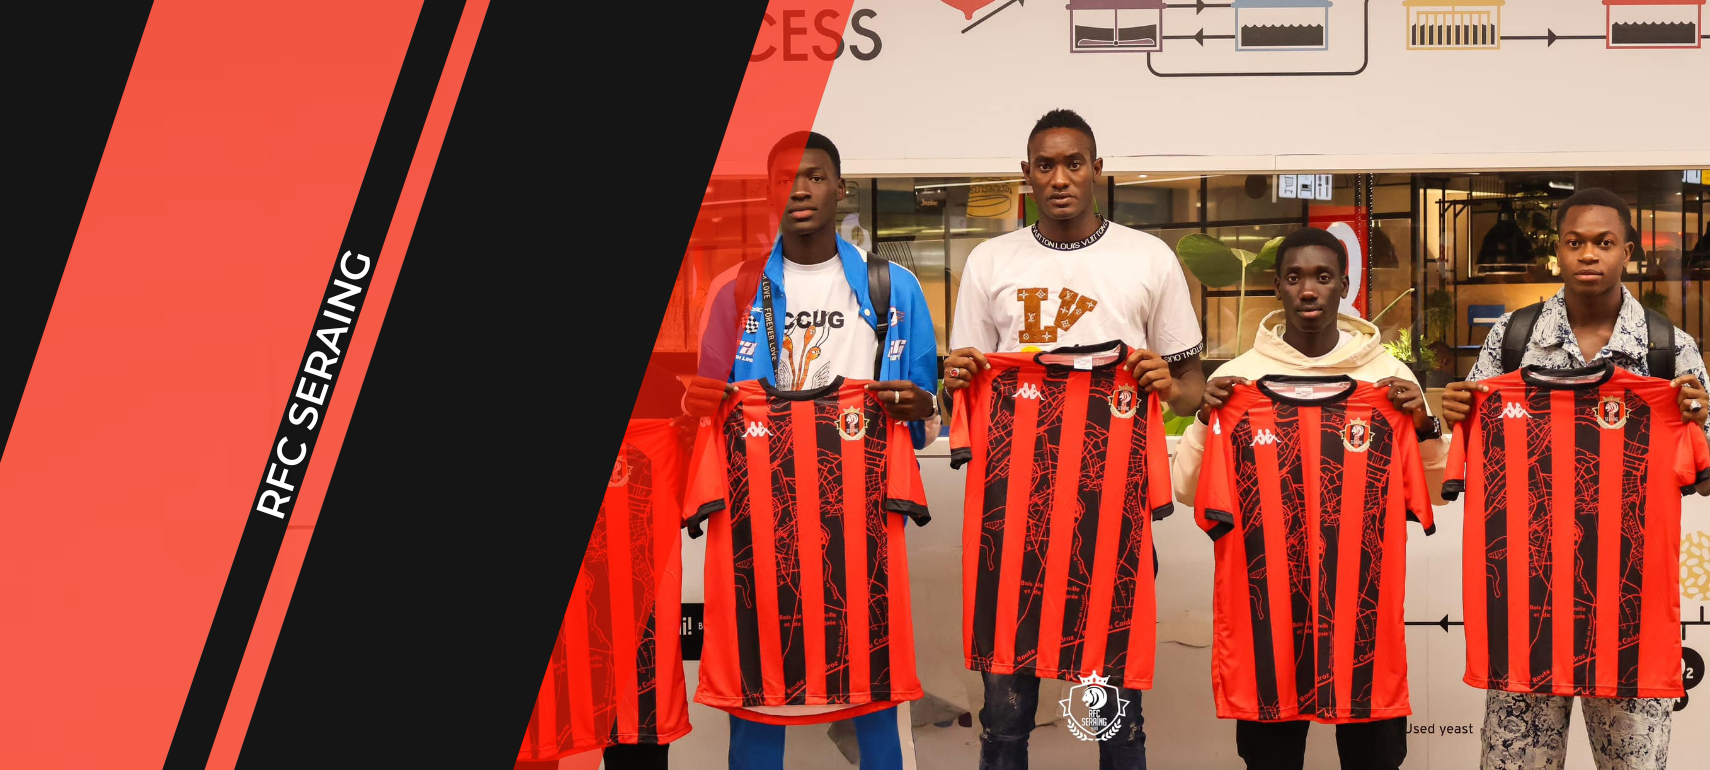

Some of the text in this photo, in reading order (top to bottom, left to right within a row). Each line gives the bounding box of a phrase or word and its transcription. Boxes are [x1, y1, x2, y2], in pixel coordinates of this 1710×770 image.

[1055, 242, 1080, 250] LOUIS
[764, 307, 775, 340] FOREVER
[1017, 287, 1098, 343] LV
[1440, 723, 1474, 736] yeast
